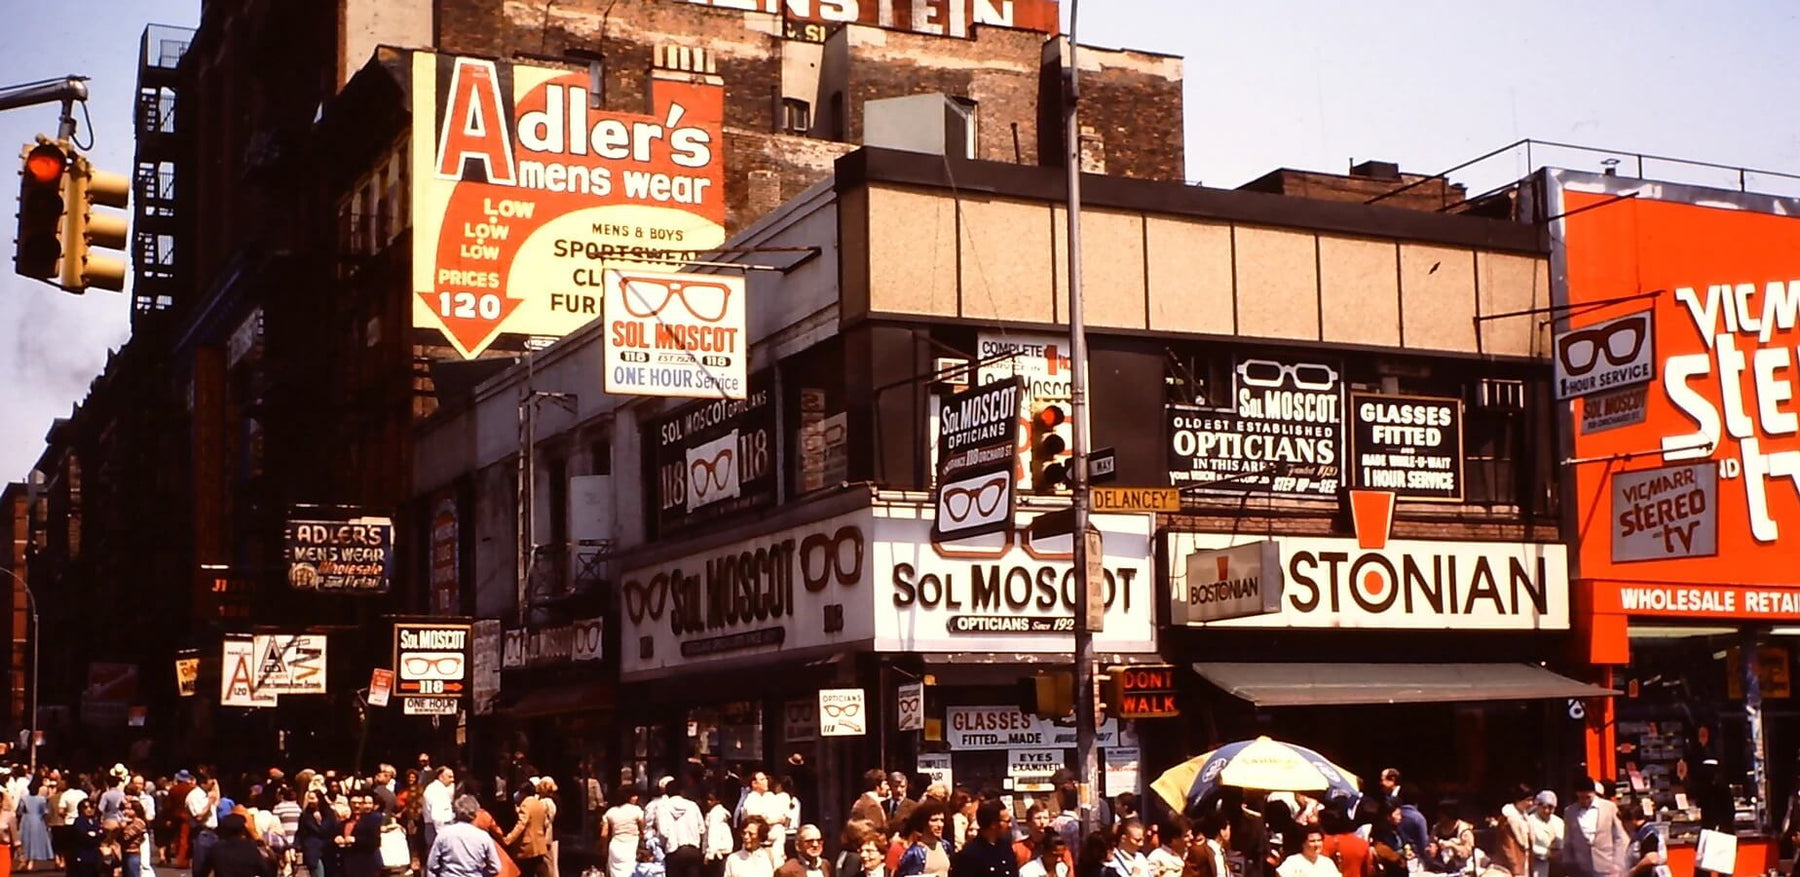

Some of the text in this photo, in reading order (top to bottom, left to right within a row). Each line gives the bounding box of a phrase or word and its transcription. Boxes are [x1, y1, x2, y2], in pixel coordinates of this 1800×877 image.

[435, 57, 712, 186] Adler's
[518, 160, 712, 204] mens wear
[484, 198, 536, 219] LOW
[464, 222, 510, 240] LOW
[592, 223, 684, 241] MENS & BOYS
[460, 244, 500, 260] LOW
[438, 269, 500, 288] PRICES
[439, 291, 502, 320] 120
[551, 294, 602, 314] FUR
[612, 320, 738, 353] SOL MOSCOT
[982, 341, 1043, 357] COMPLETE
[614, 366, 739, 390] ONE HOUR Service
[1599, 363, 1649, 387] SERVICE
[961, 386, 1017, 430] MOSCOT
[1265, 390, 1338, 424] MOSCOT
[1360, 402, 1452, 427] GLASSES
[662, 420, 683, 445] SOL
[685, 399, 727, 435] MOSCOT
[1173, 417, 1334, 437] OLDEST ESTABLISHED
[948, 422, 1006, 449] OPTICIANS
[1372, 425, 1442, 447] FITTED
[740, 429, 768, 483] 118
[1173, 430, 1335, 464] OPTICIANS
[1193, 458, 1277, 474] IN THIS ARE
[661, 461, 685, 510] 118
[1363, 467, 1455, 490] 1 HOUR SERVICE
[1622, 468, 1695, 503] VICMARR
[1094, 490, 1168, 509] DELANCEY
[298, 524, 383, 545] ADLER'S
[294, 547, 386, 562] MENS WEAR
[706, 538, 797, 630] MOSCOT
[1190, 576, 1258, 606] BOSTONIAN
[1281, 550, 1549, 616] STONIAN
[1620, 588, 1736, 612] WHOLESALE
[956, 616, 1030, 631] OPTICIANS
[419, 630, 466, 650] MOSCOT
[419, 680, 444, 694] 118
[407, 699, 455, 709] ONE HOUR
[823, 695, 862, 703] OPTICIANS
[1124, 696, 1176, 712] WALK
[953, 712, 1031, 731] GLASSES
[962, 732, 998, 745] FITTED
[1008, 732, 1042, 744] MADE
[1019, 753, 1053, 762] EYES
